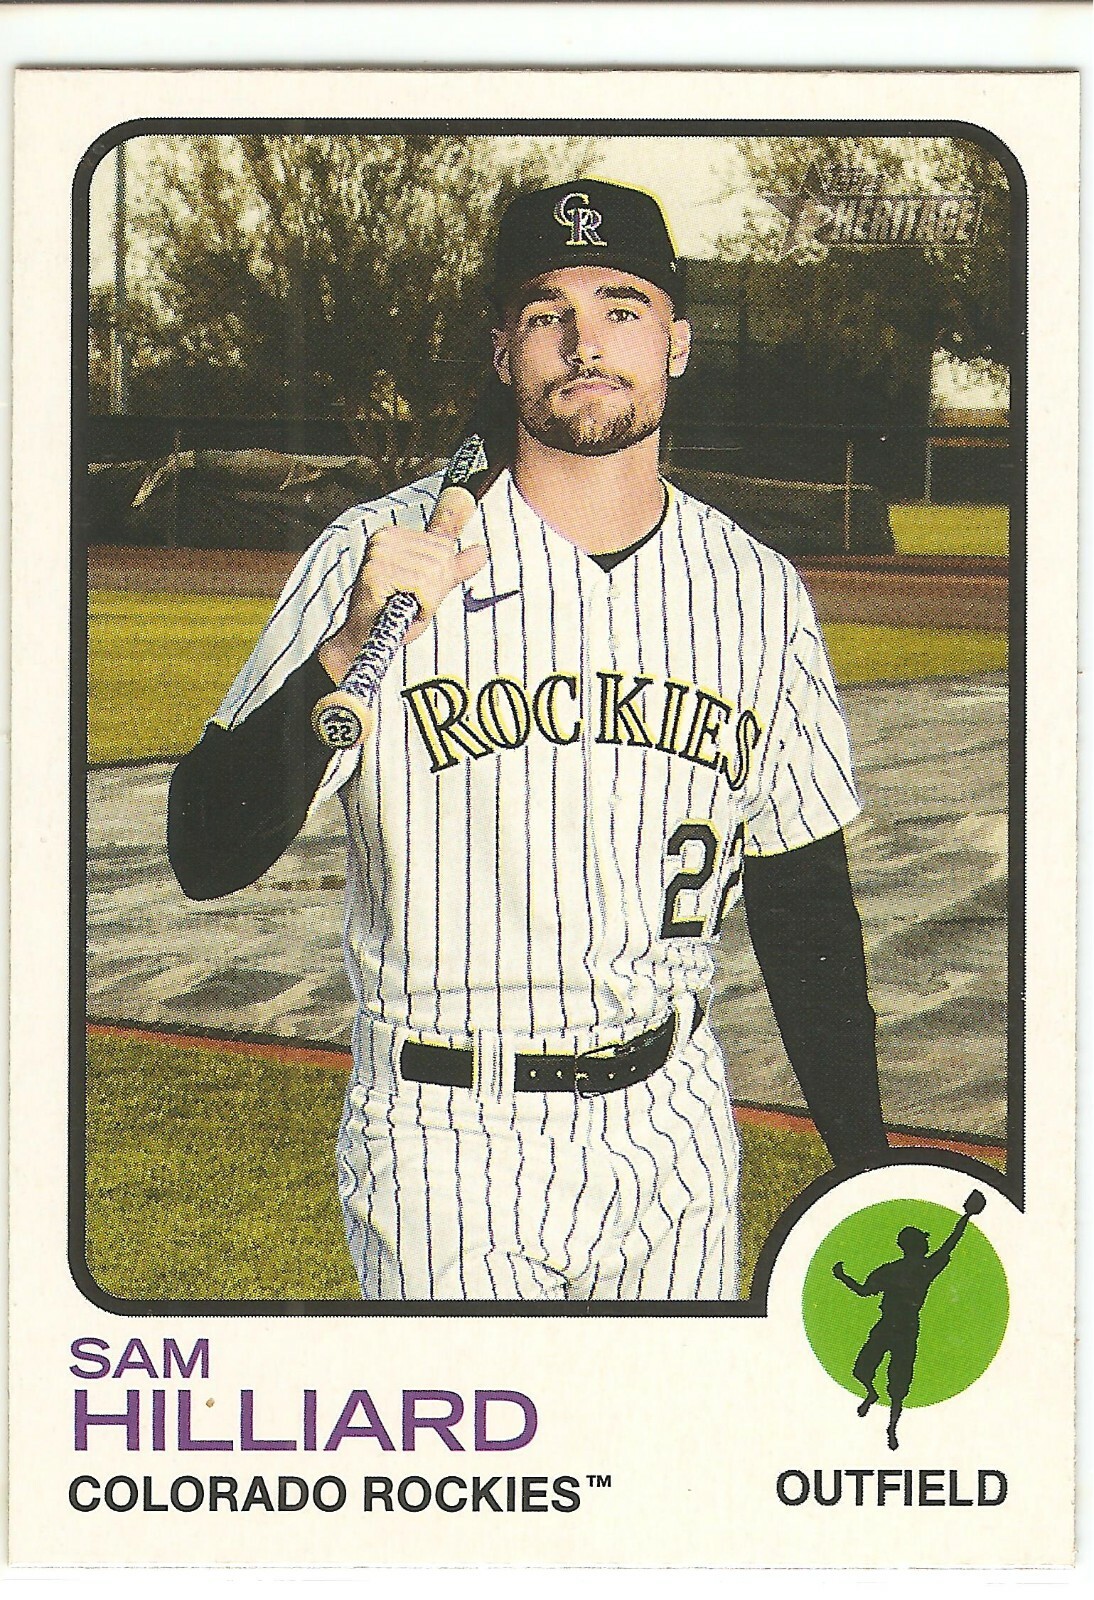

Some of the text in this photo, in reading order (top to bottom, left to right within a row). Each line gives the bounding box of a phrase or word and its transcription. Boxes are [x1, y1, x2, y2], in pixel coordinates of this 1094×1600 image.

[831, 199, 976, 241] HERITAGE
[327, 724, 353, 742] 22
[400, 671, 763, 791] ROCKIES
[69, 1337, 210, 1380] SAM
[74, 1389, 538, 1452] HILLIARD
[68, 1475, 347, 1513] COLORADO
[776, 1469, 1008, 1507] OUTFIELD
